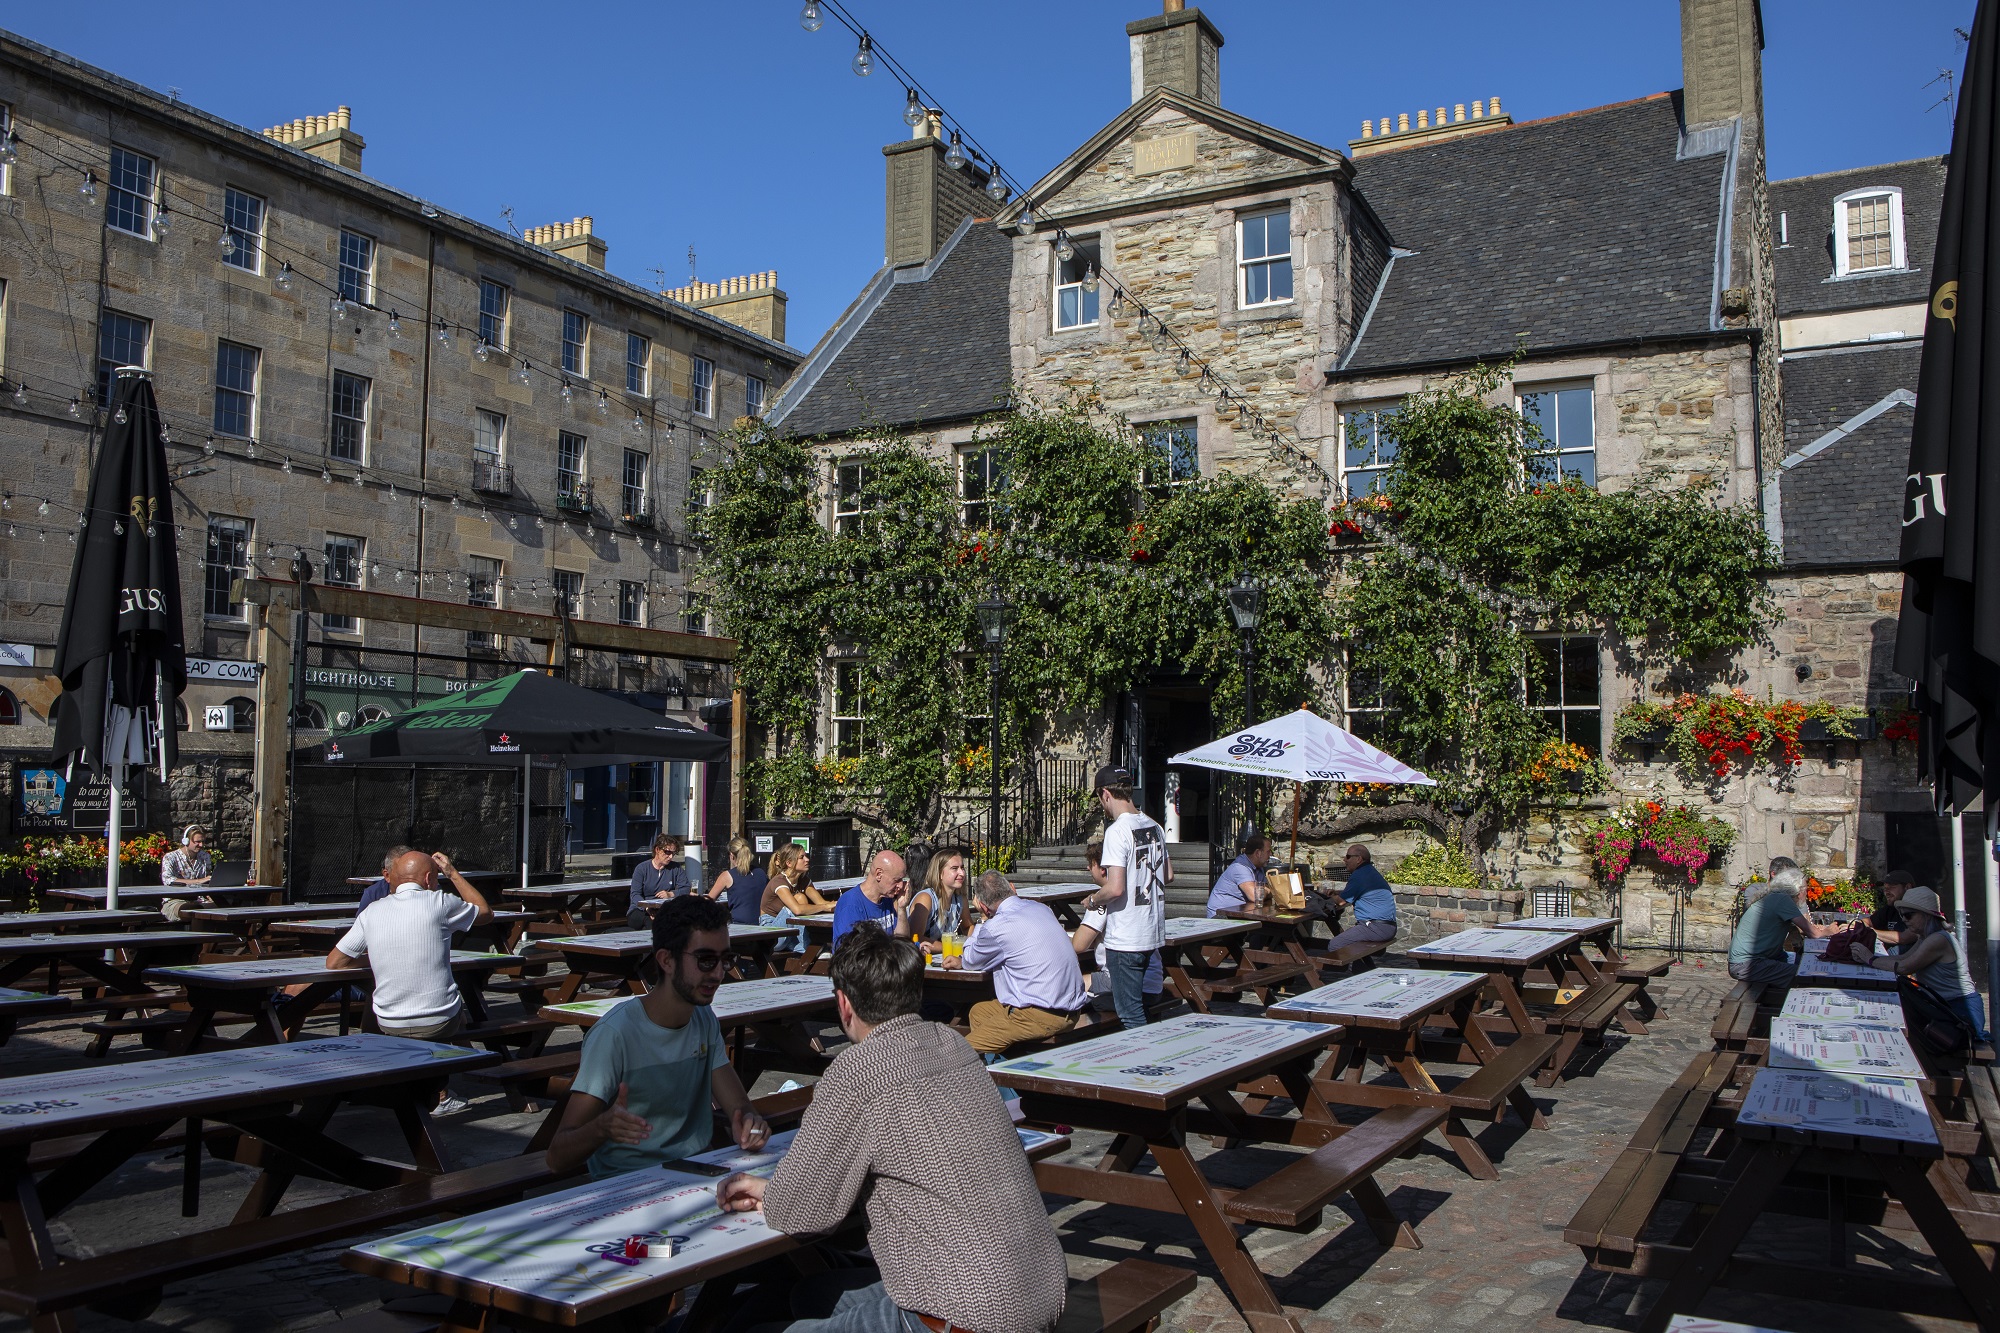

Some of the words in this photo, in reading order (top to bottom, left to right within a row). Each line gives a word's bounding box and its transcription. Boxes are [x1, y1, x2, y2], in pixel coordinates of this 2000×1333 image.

[305, 670, 396, 688] LIGHTHOUSE
[490, 744, 521, 753] Heineken
[1187, 756, 1226, 768] Alcoholic
[1227, 762, 1266, 772] sparkling
[1267, 767, 1293, 775] water
[1305, 770, 1347, 780] LIGHT
[79, 786, 86, 796] to
[88, 788, 102, 796] our
[73, 798, 87, 809] long
[87, 799, 102, 809] may
[18, 817, 32, 828] The
[33, 816, 52, 827] Pear
[52, 816, 69, 827] Tree
